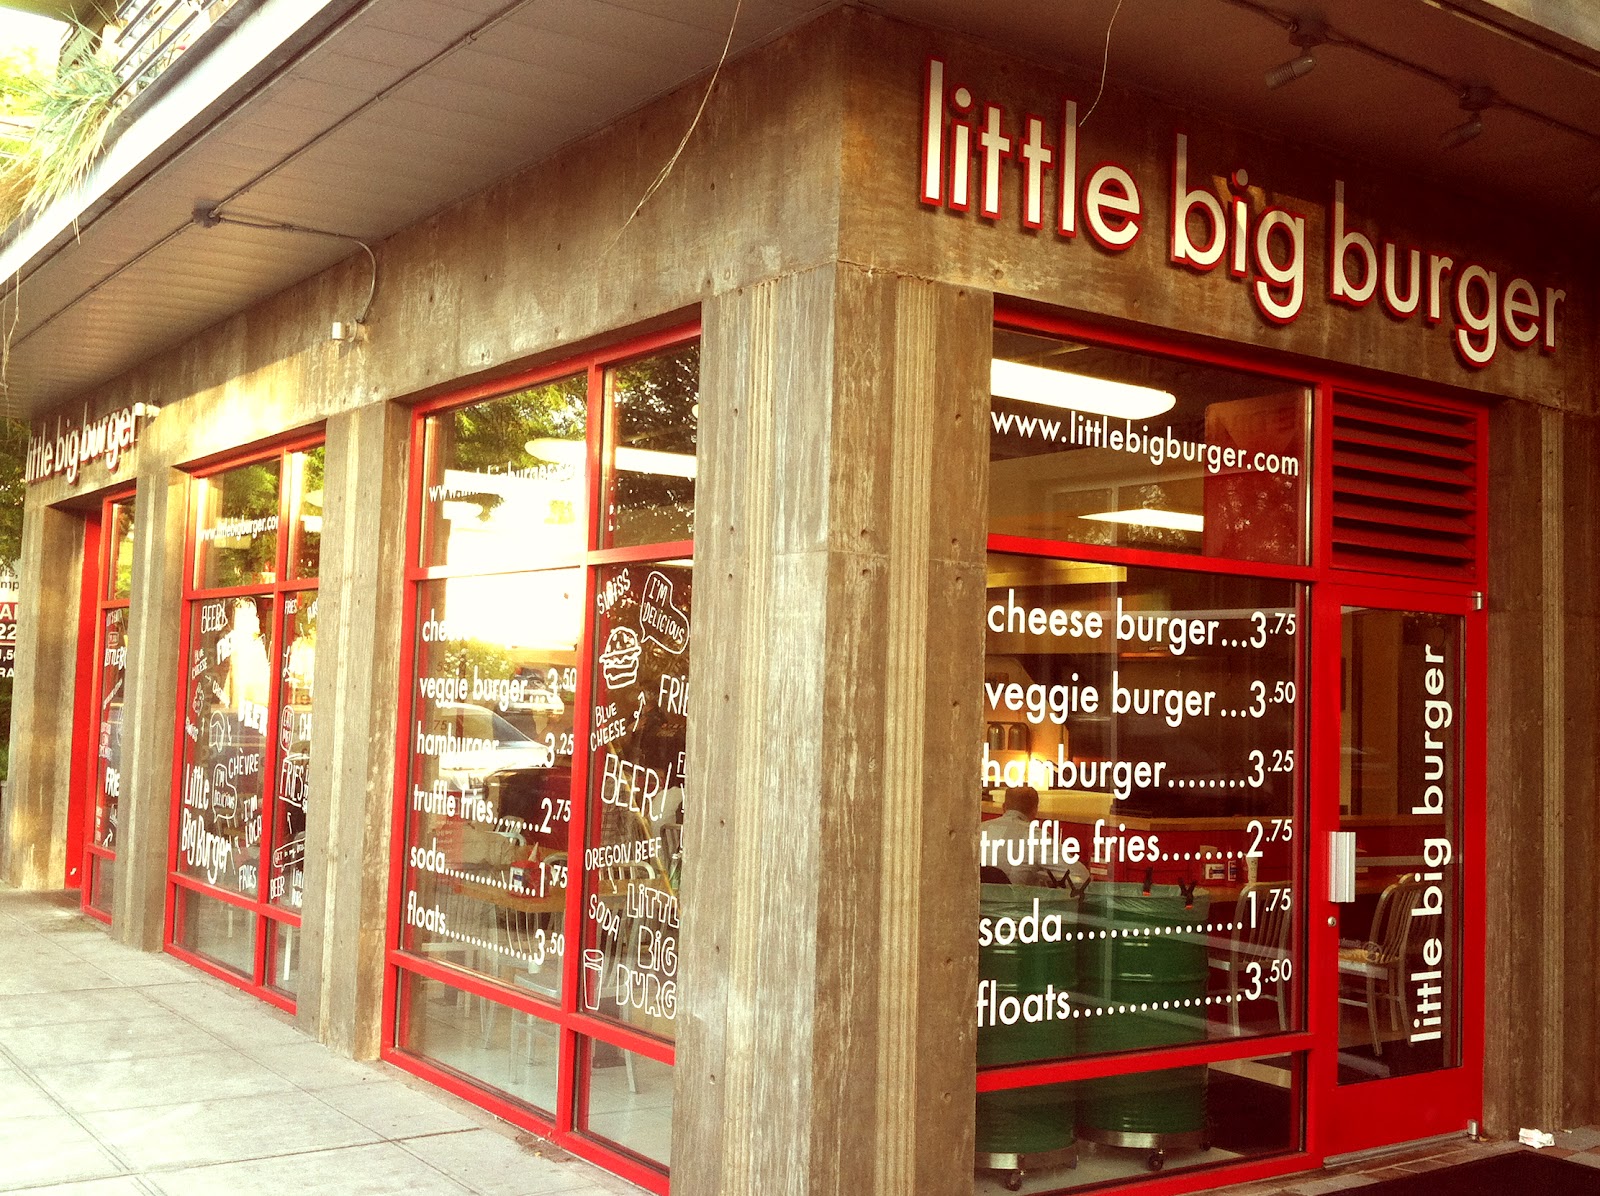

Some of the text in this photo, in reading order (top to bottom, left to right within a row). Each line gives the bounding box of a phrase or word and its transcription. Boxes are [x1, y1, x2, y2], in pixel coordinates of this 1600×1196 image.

[921, 55, 1566, 368] little big burger
[25, 402, 137, 484] little big burger
[990, 411, 1300, 478] www.littlebigburger.com
[987, 589, 1104, 638] cheese
[419, 668, 469, 709] veggie
[984, 672, 1099, 725] veggie
[590, 717, 627, 752] CHEESE
[595, 702, 617, 727] BLUE
[184, 763, 210, 811] Little
[228, 748, 260, 779] CHÈVRE
[413, 779, 456, 818] truffle
[181, 808, 232, 885] Big Burger
[584, 836, 663, 872] OREGON BEEF
[979, 819, 1081, 867] truffle
[1410, 644, 1453, 1042] little big burger
[588, 893, 621, 942] SODA
